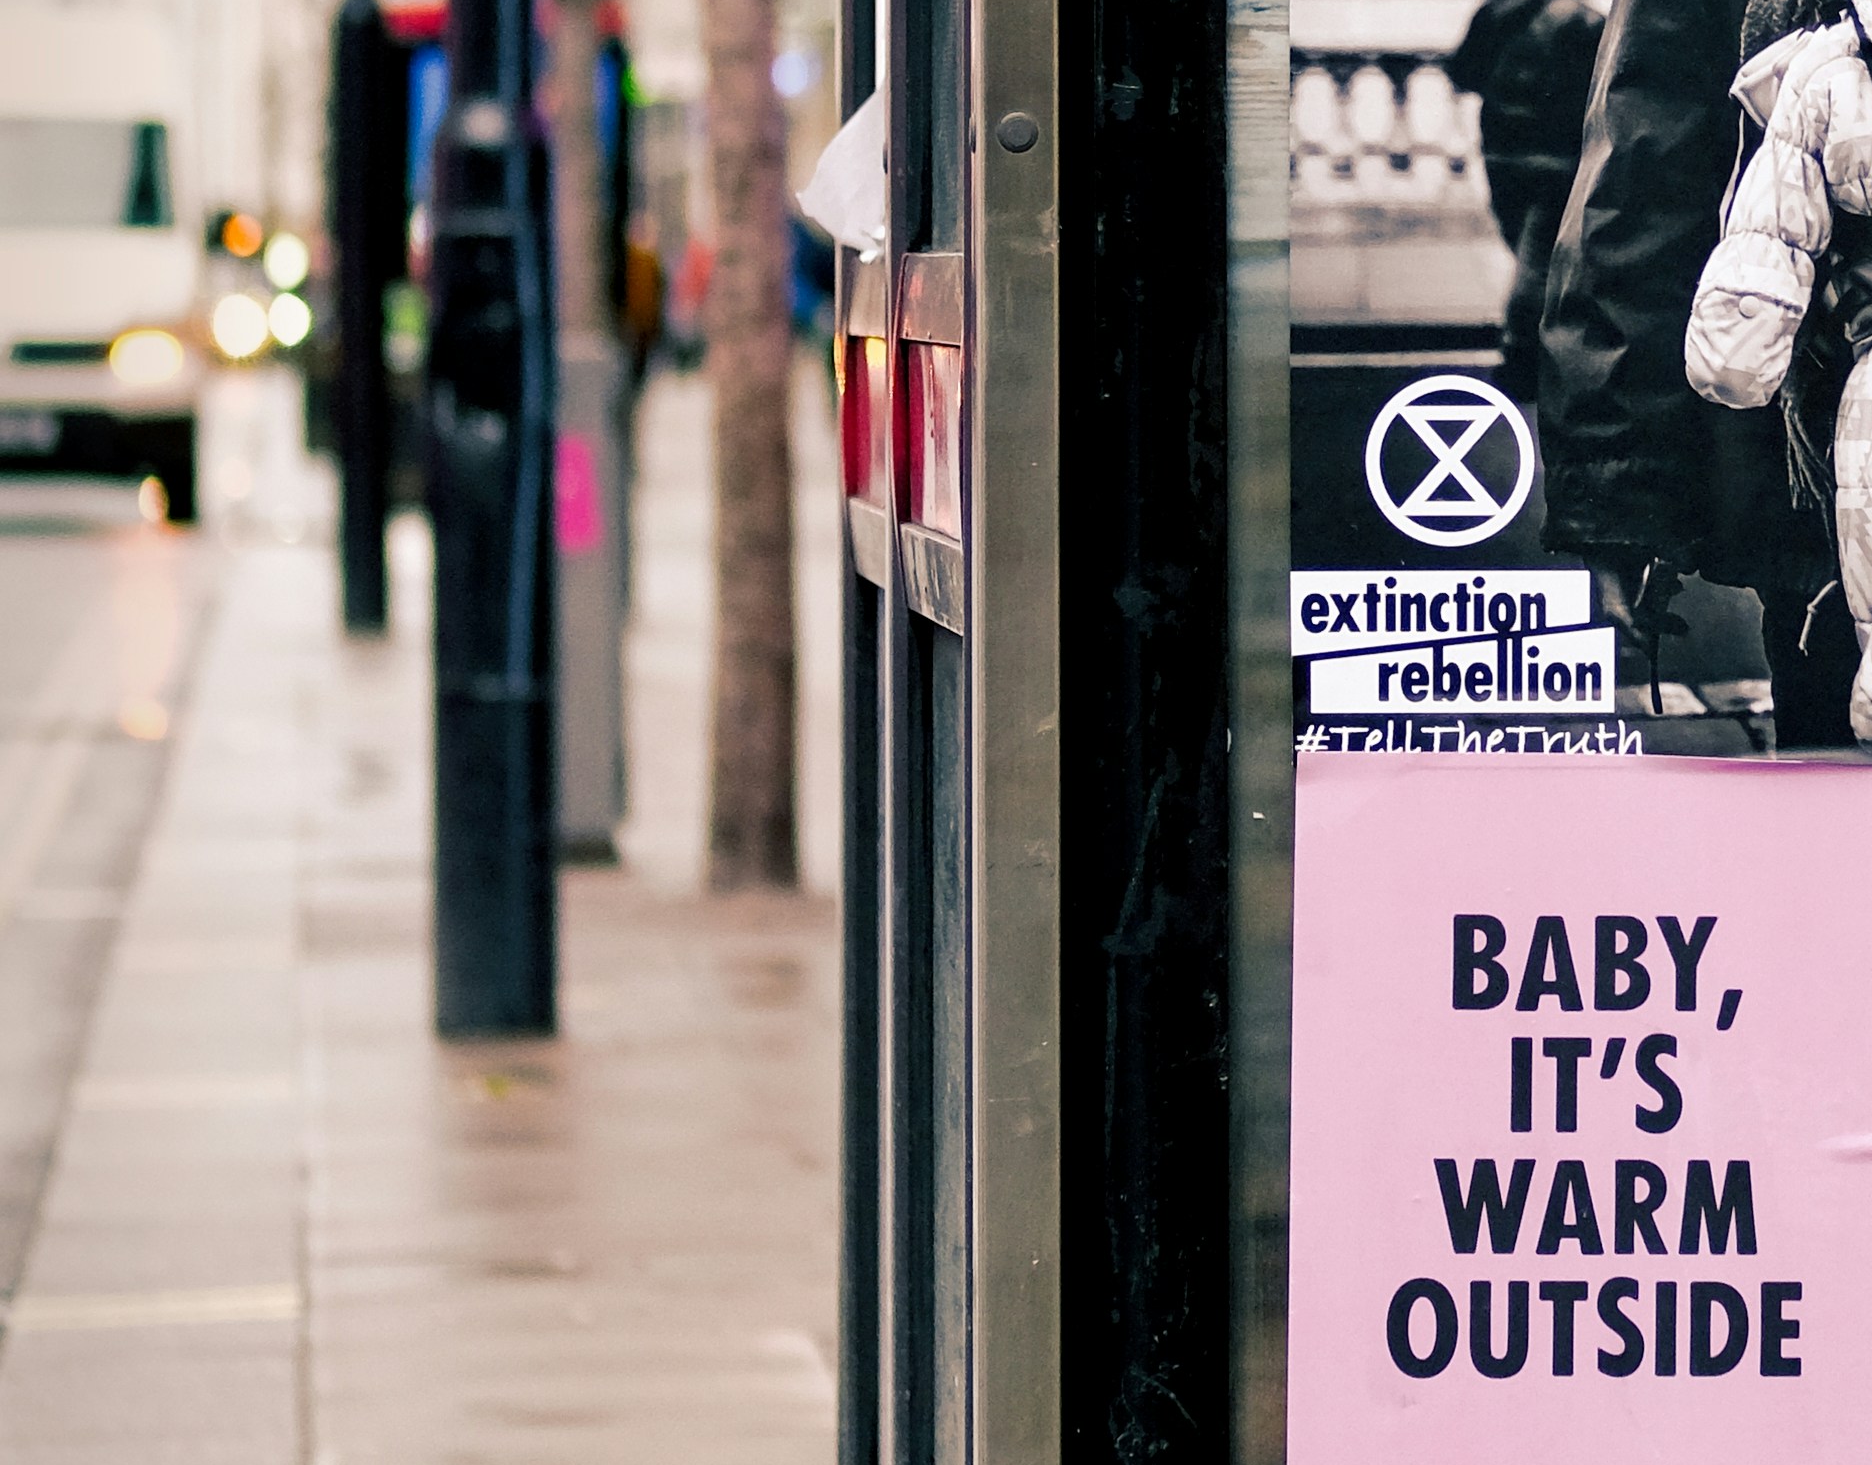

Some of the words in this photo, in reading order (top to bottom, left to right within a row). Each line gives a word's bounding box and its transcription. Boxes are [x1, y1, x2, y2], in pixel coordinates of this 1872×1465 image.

[1300, 575, 1548, 634] extinction
[1377, 636, 1602, 703] rebellion
[1294, 719, 1643, 756] #TellTheTruth
[1451, 913, 1744, 1031] BABY,
[1509, 1032, 1684, 1135] IT'S
[1433, 1157, 1758, 1257] WARM
[1385, 1275, 1803, 1380] OUTSIDE
